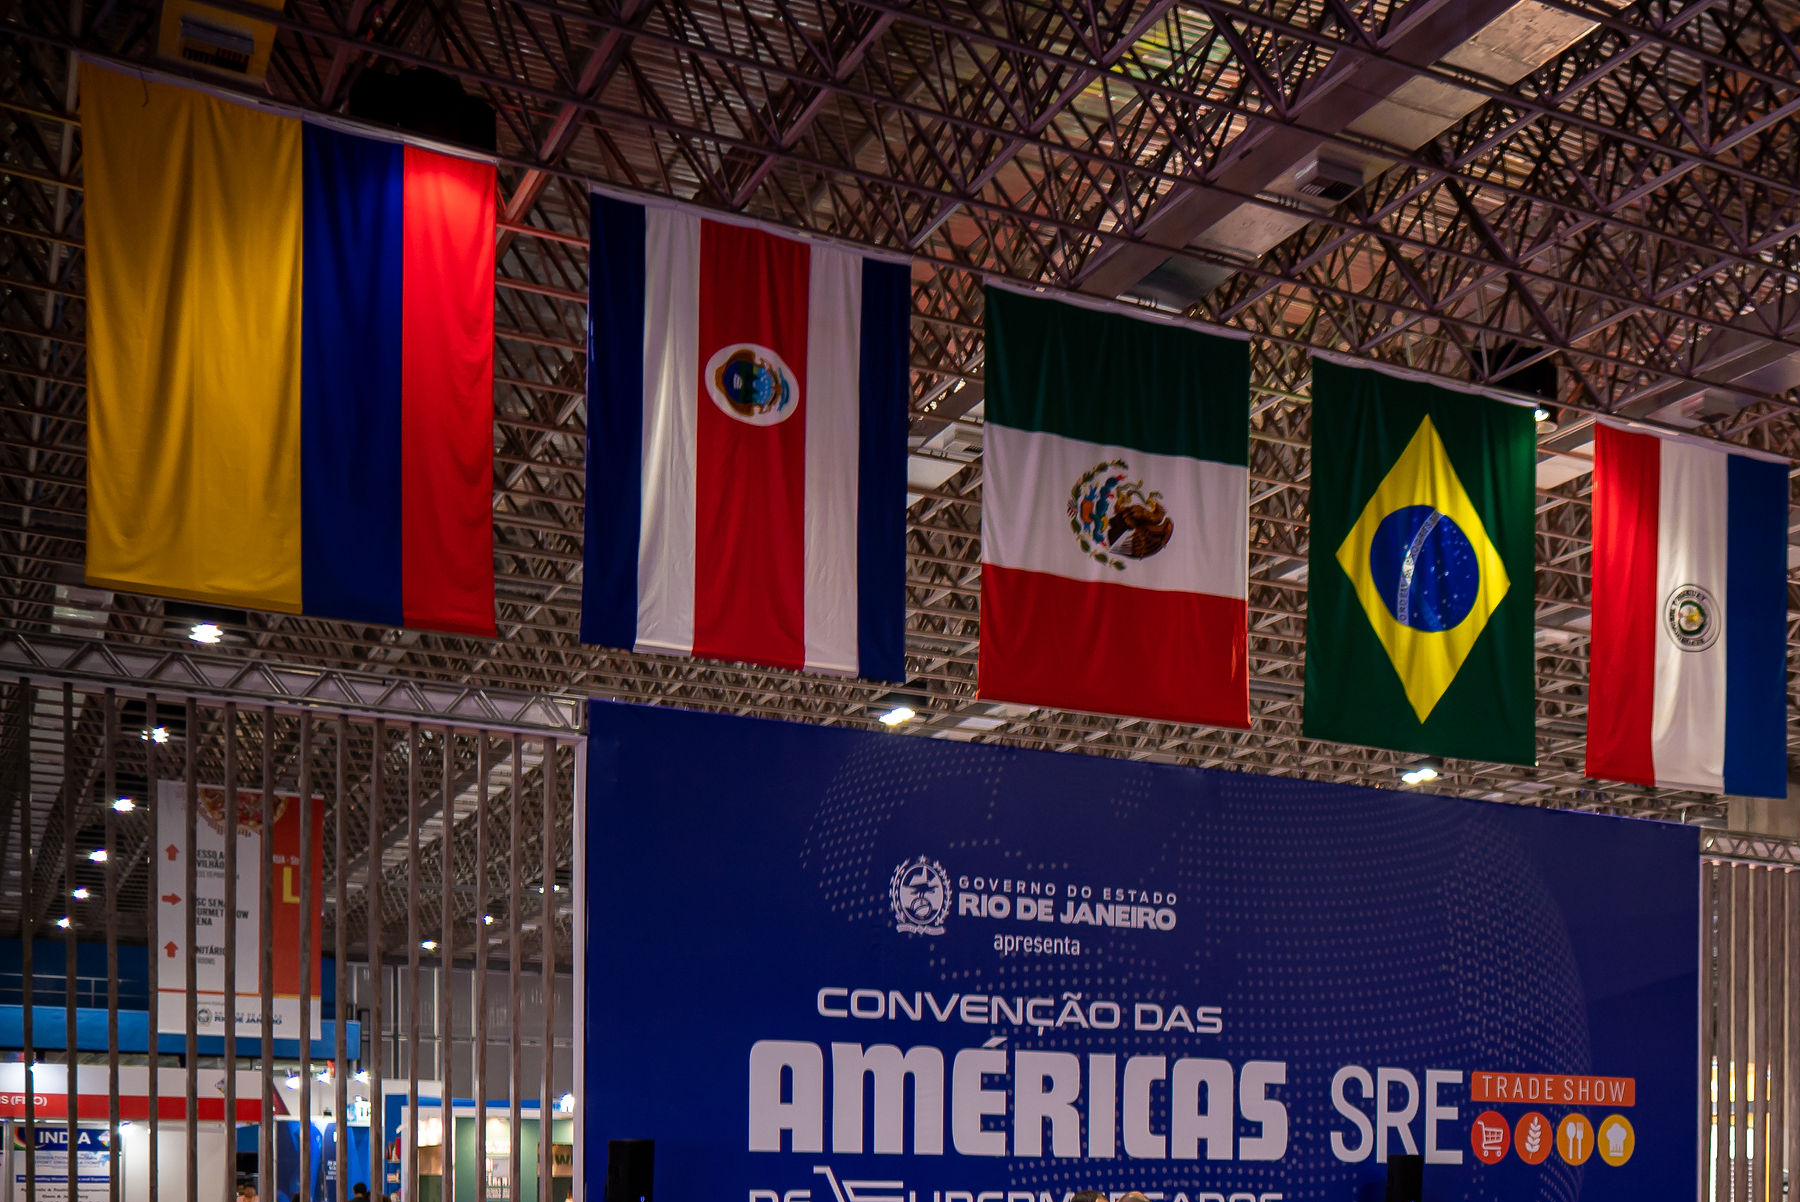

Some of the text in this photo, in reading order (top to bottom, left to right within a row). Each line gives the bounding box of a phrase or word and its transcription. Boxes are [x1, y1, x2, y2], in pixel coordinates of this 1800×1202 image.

[958, 874, 1177, 906] GOVERNO DO ESTADO
[958, 891, 1177, 931] RIO DE JANEIRO
[993, 932, 1081, 956] apresenta
[816, 986, 1223, 1036] CONVENÇÃO DAS
[748, 1036, 1288, 1161] AMÉRICAS
[1482, 1074, 1627, 1103] TRADE SHOW
[1329, 1064, 1464, 1165] SRE
[39, 1130, 92, 1145] INDA
